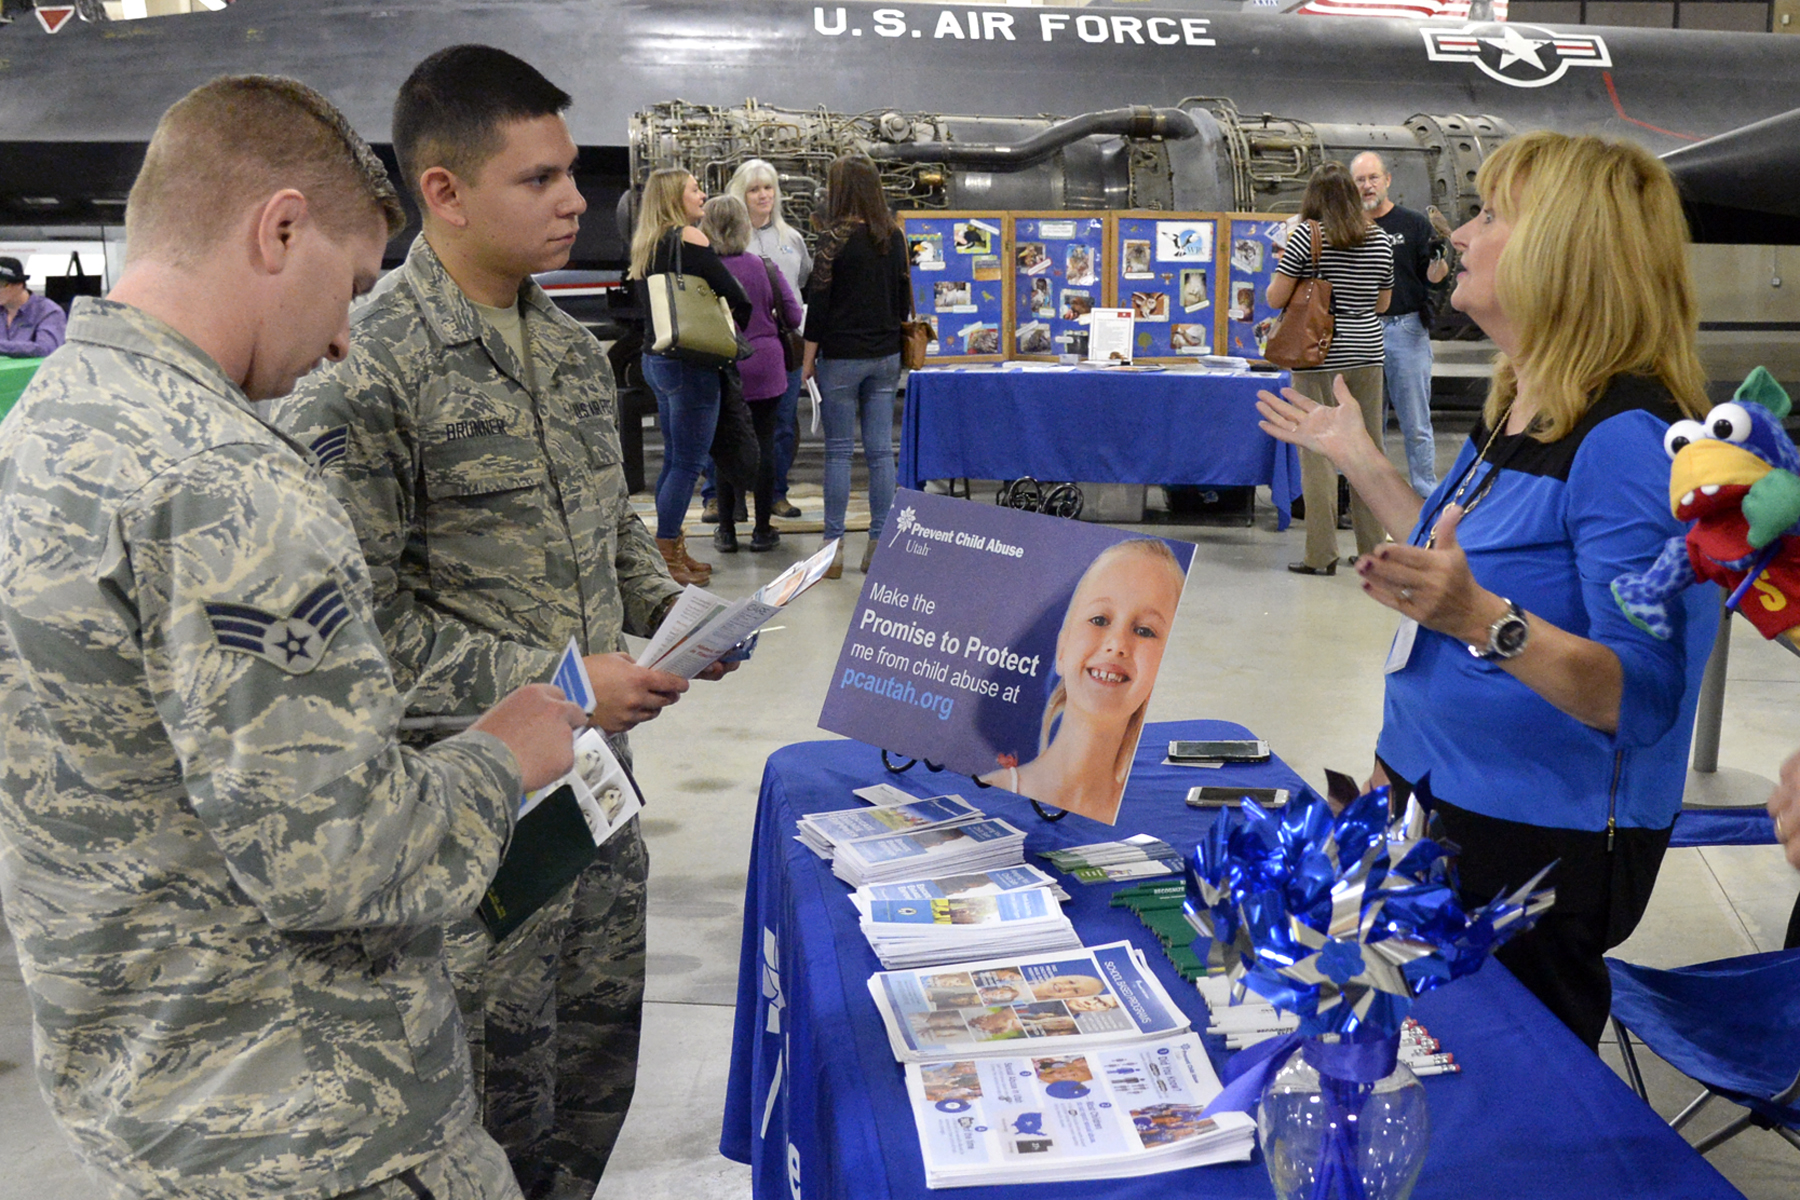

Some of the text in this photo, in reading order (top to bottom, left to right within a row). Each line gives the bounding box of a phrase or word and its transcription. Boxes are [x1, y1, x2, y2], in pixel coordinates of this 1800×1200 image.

[933, 10, 1017, 42] AIR
[1038, 13, 1217, 47] FORCE
[446, 418, 508, 441] BRUNNER
[905, 539, 931, 557] Utah
[911, 522, 1025, 559] Prevent Child Abuse
[869, 582, 936, 615] Make the
[859, 608, 1040, 677] Promise to Protect
[850, 642, 1021, 704] me from child abuse at
[840, 667, 955, 721] pcautah.org
